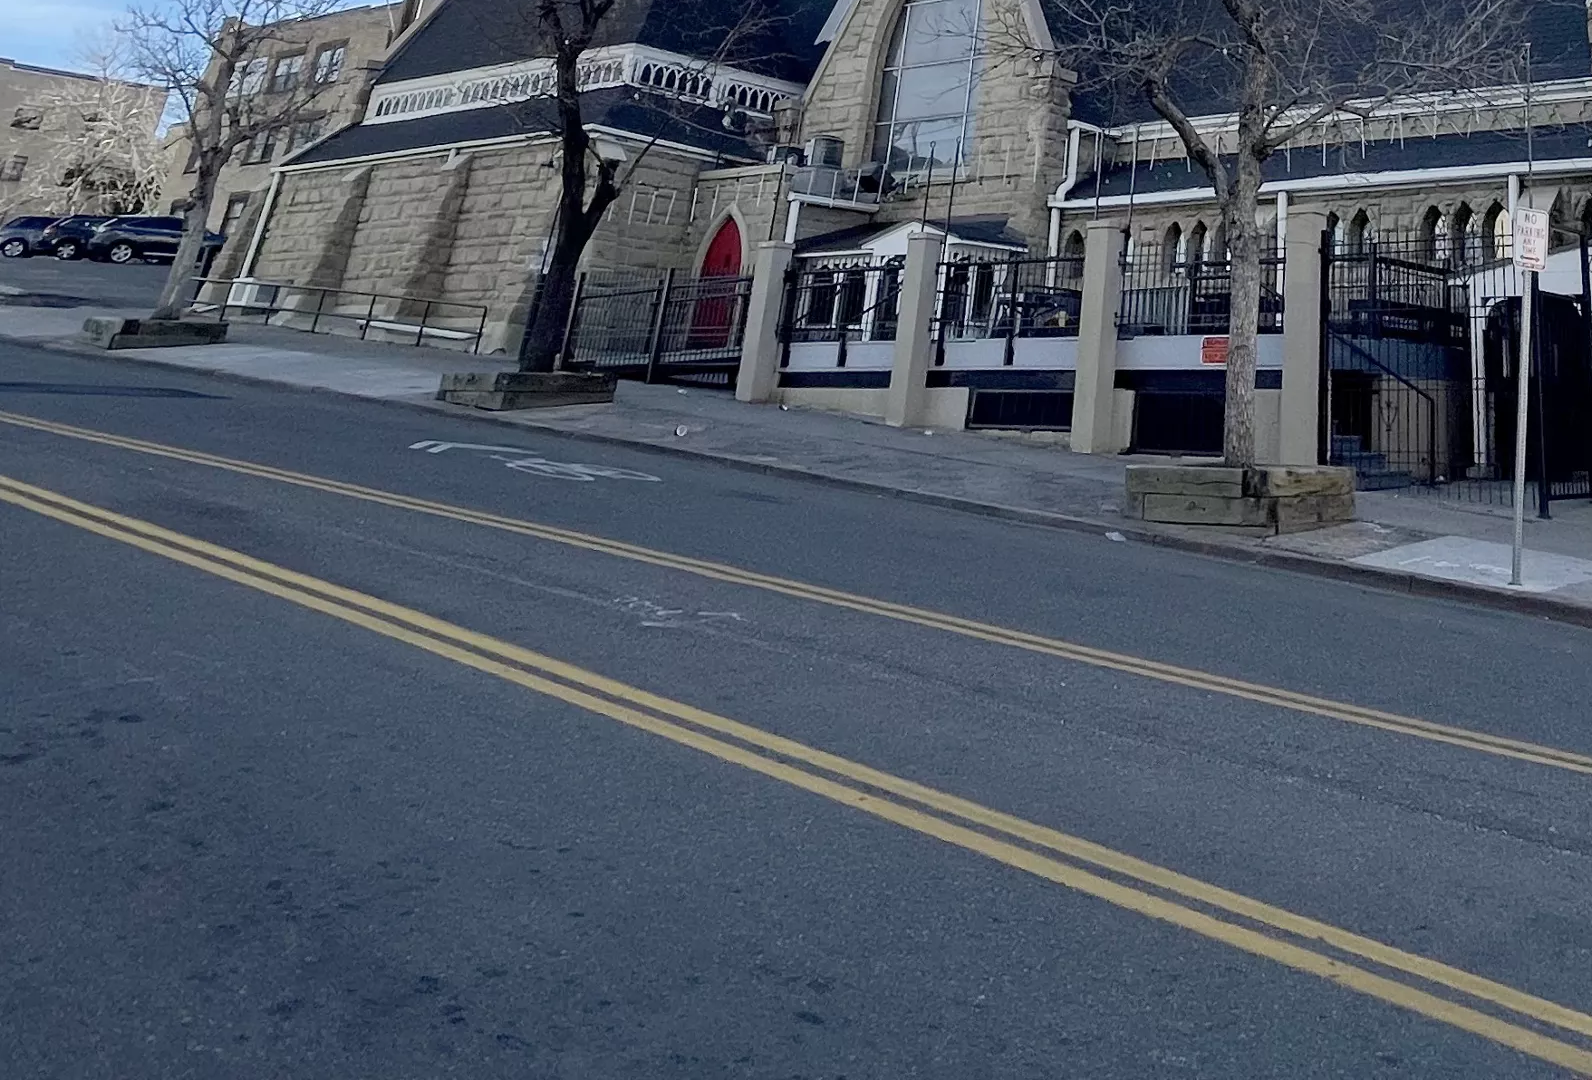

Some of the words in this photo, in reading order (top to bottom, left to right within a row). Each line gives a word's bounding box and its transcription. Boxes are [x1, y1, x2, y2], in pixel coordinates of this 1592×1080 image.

[1524, 213, 1537, 225] NO
[1517, 225, 1545, 239] PARKING
[1523, 238, 1536, 246] ANY
